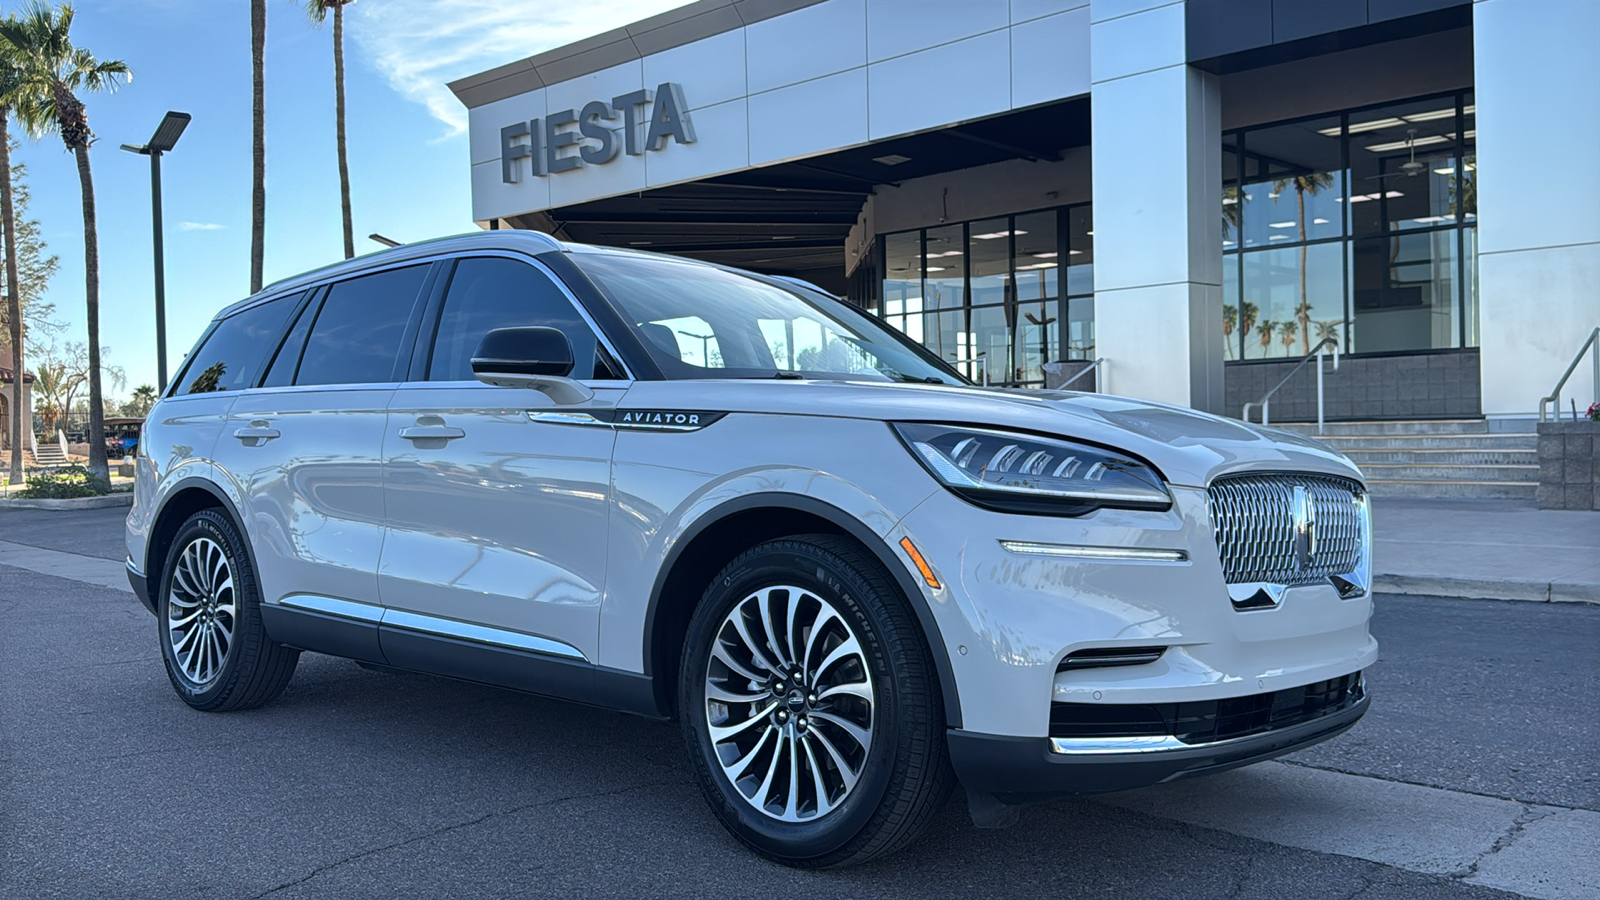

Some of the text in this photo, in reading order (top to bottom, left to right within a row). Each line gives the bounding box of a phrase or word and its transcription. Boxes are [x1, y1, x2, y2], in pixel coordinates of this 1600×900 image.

[500, 82, 697, 184] FIESTA
[623, 412, 700, 424] AVIATOR
[209, 525, 231, 557] MICHELIN
[842, 593, 886, 672] MICHELIN
